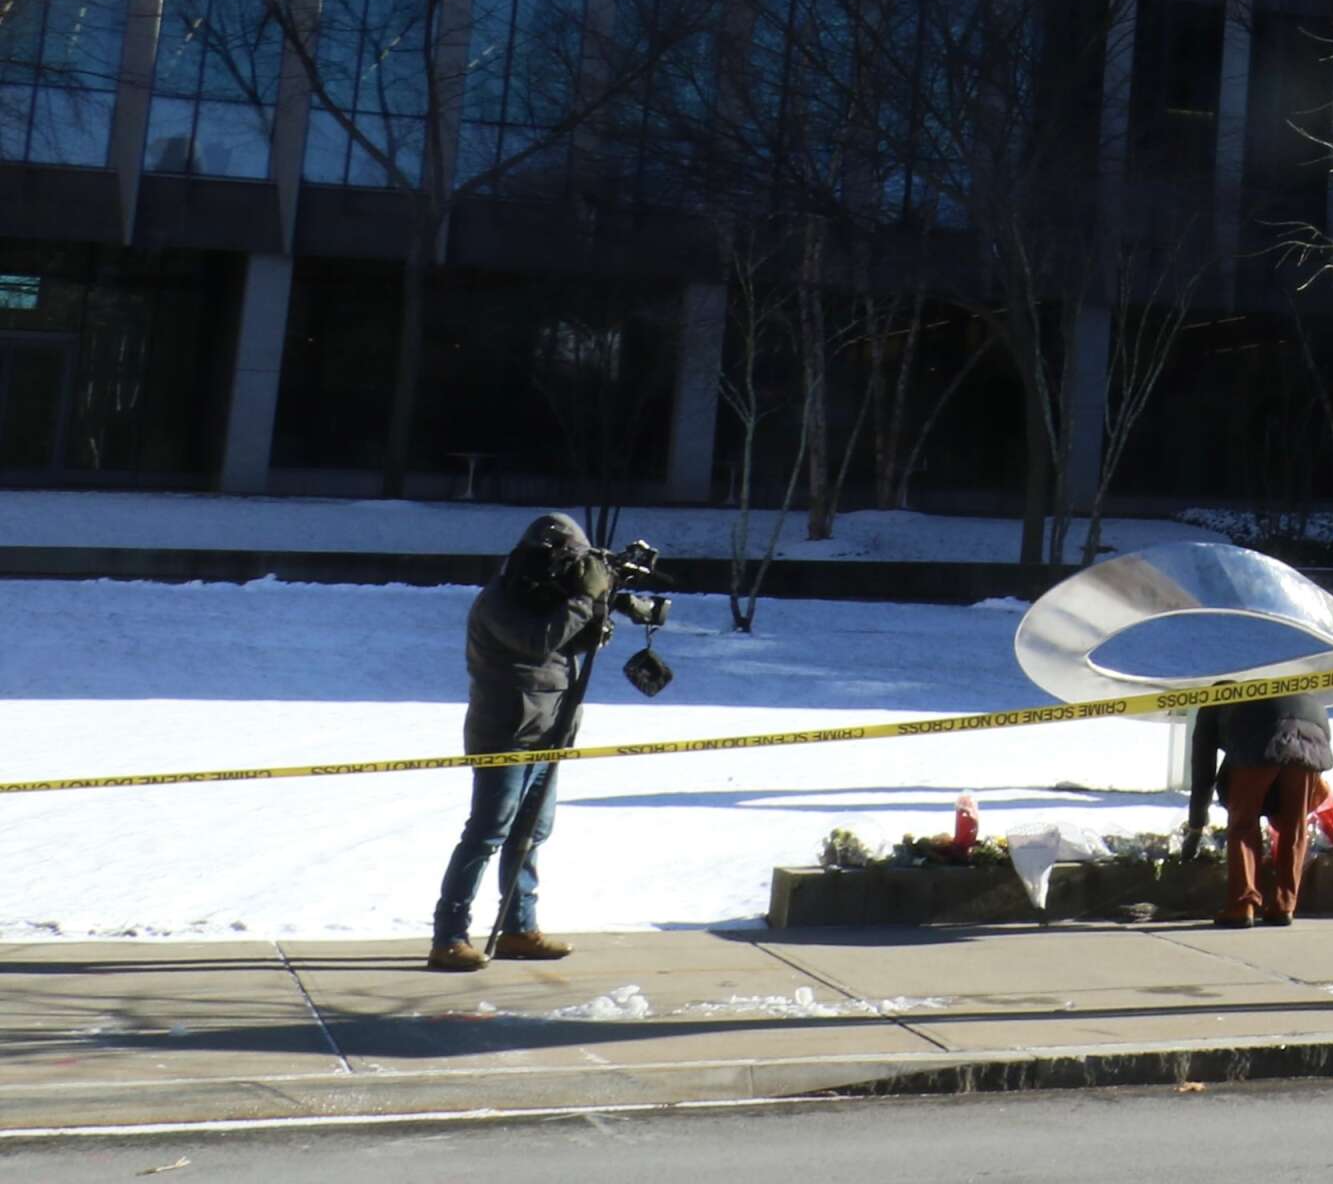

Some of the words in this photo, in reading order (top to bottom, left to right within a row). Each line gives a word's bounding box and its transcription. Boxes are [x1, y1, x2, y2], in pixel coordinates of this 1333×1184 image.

[1246, 682, 1268, 697] DO
[1271, 676, 1319, 694] SCENE
[1157, 690, 1209, 708] CROSS
[1212, 686, 1243, 702] NOT
[1023, 706, 1074, 724] SCENE
[1079, 701, 1126, 717] CRIME
[898, 719, 954, 735] CROSS
[960, 716, 991, 730] NOT
[994, 712, 1018, 726] DO
[721, 736, 746, 748] DO
